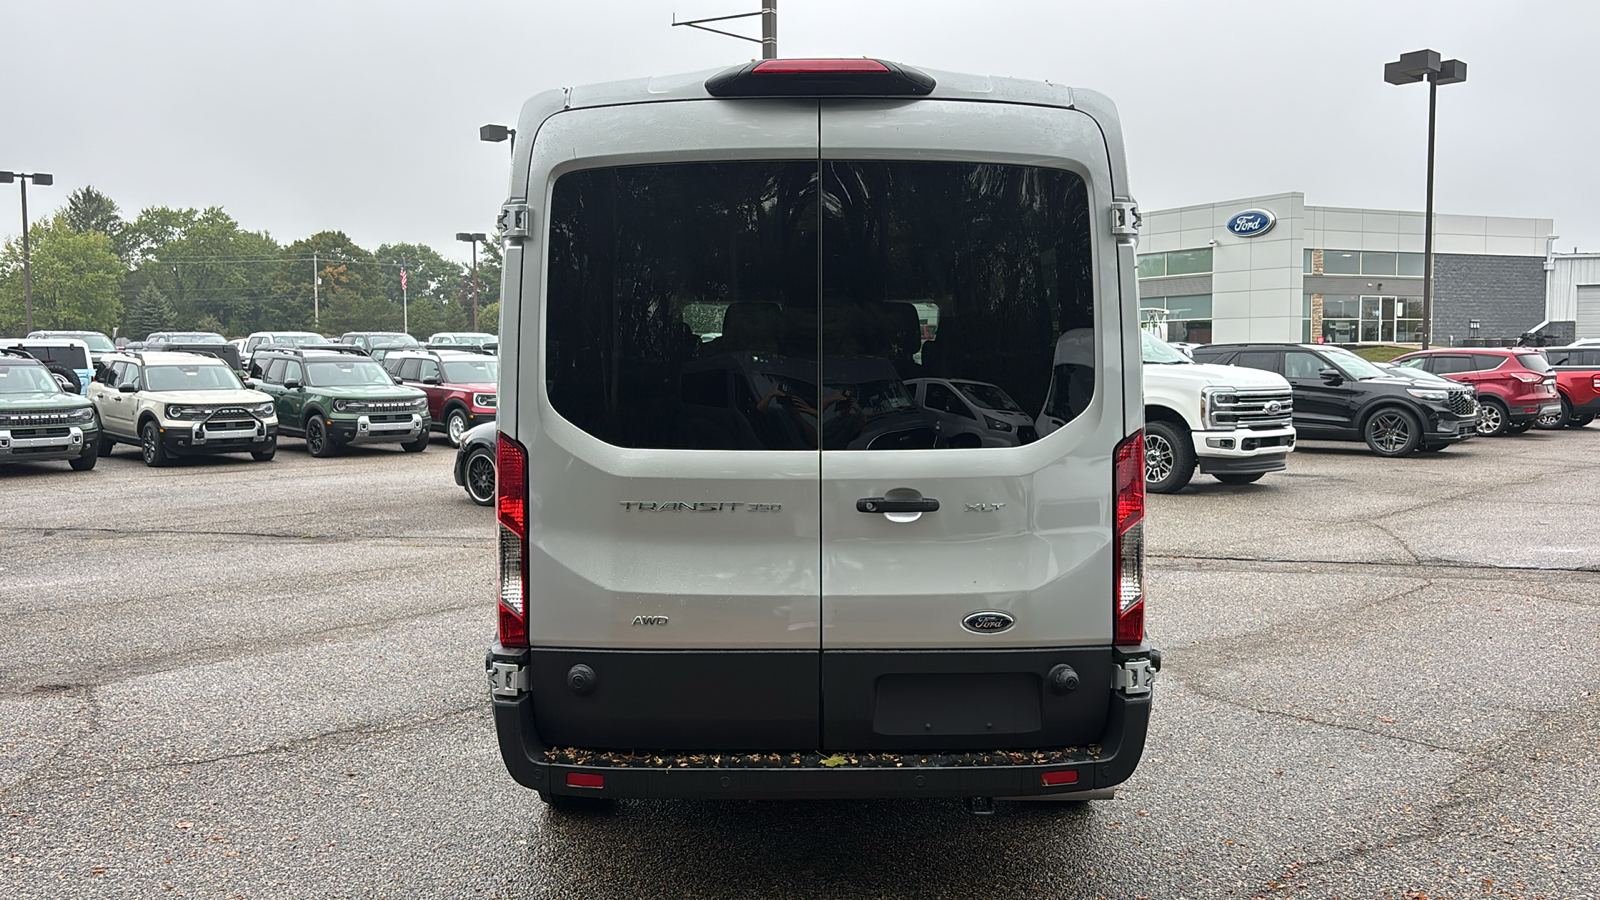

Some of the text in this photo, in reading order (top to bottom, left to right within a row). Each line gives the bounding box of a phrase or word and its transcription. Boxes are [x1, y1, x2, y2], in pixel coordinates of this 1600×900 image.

[1234, 215, 1261, 232] Ford
[619, 500, 782, 513] TRANSIT 350
[964, 502, 1006, 513] XLT
[631, 615, 669, 626] AWD
[975, 616, 1003, 628] Ford
